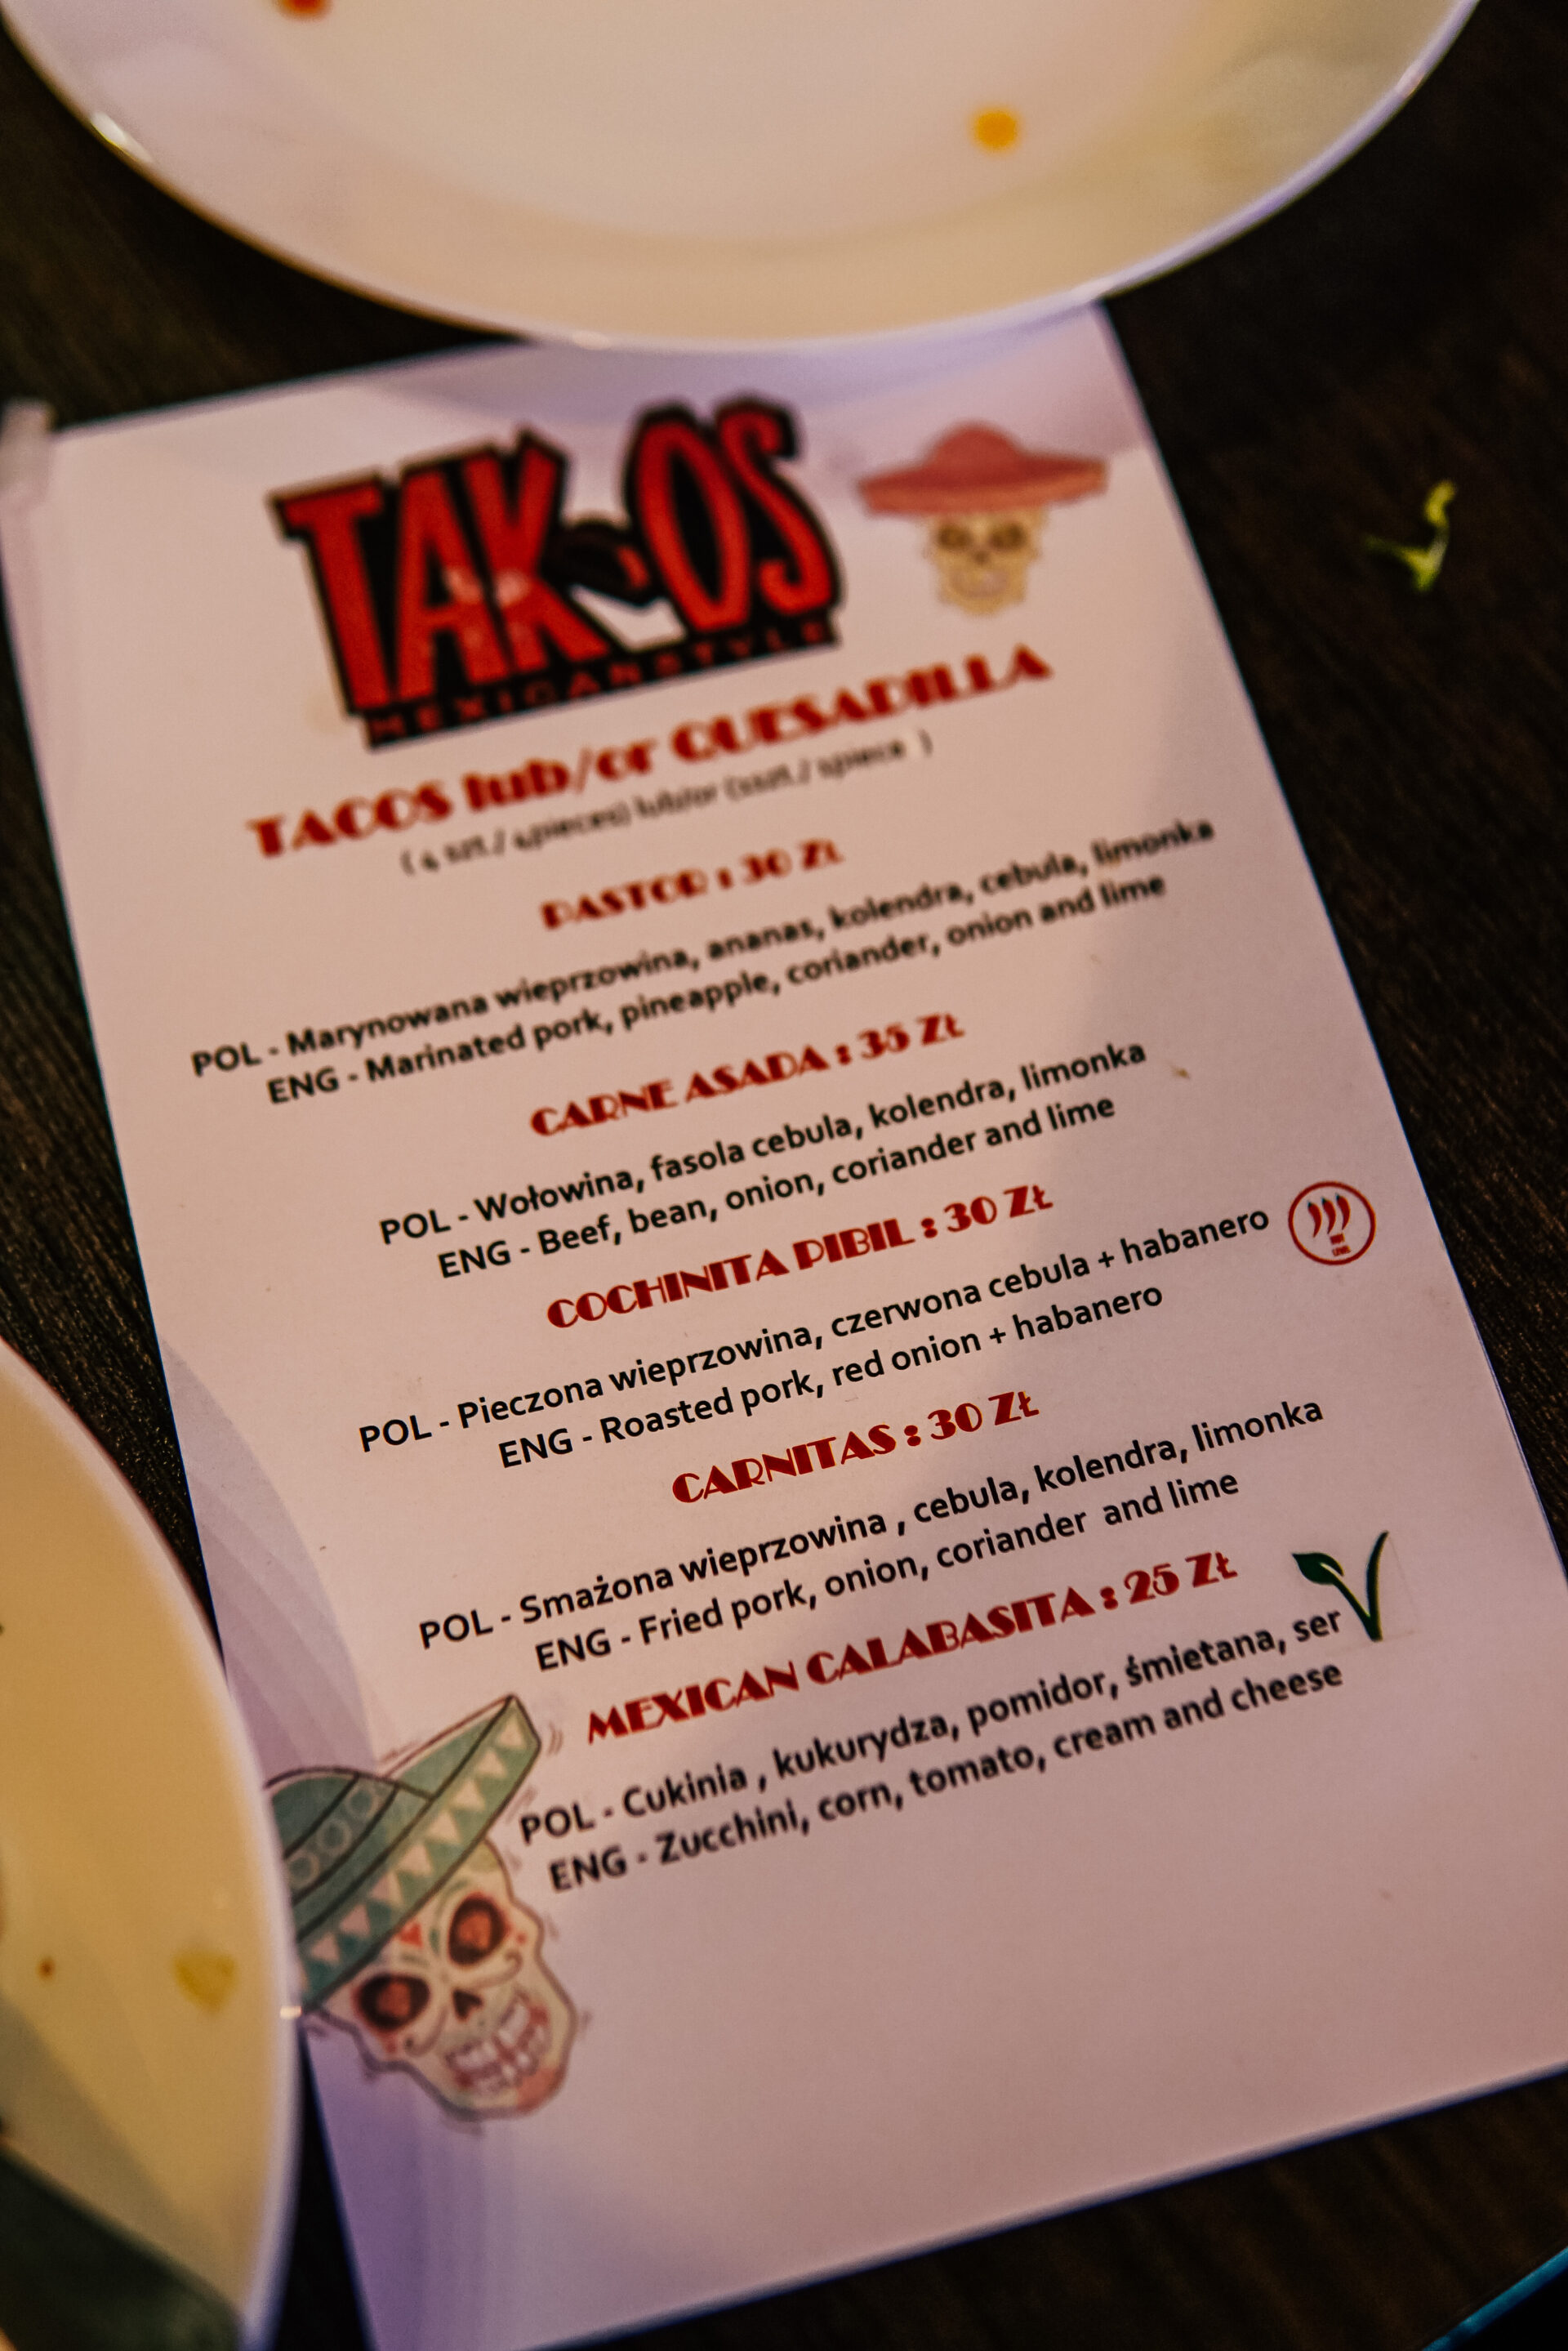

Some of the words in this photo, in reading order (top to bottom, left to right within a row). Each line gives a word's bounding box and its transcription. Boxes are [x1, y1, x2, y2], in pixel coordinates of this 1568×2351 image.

[247, 783, 454, 859] TACOS
[670, 644, 1054, 765] QUESADILLA
[190, 1042, 263, 1077] POL
[285, 994, 490, 1057] Marynowana
[493, 948, 701, 1010] wieprzowina,
[706, 918, 826, 961] ananas,
[827, 882, 974, 931] kolendra,
[978, 852, 1089, 895] cebula,
[1090, 820, 1215, 866] limonka
[539, 868, 708, 931] PASTOR
[741, 849, 792, 885] 30
[798, 838, 844, 872] ZŁ
[266, 1065, 340, 1104] ENG
[365, 1023, 527, 1083] Marinated
[532, 1004, 614, 1052] pork,
[619, 970, 782, 1032] pineapple,
[785, 934, 941, 985] coriander,
[945, 908, 1034, 947] onion
[1038, 887, 1096, 925] and
[1098, 876, 1166, 908] lime
[529, 1078, 679, 1137] CARNE
[684, 1044, 831, 1104] ASADA
[858, 1023, 911, 1060] 35
[379, 1209, 452, 1245] POL
[473, 1170, 645, 1222] Wołowina,
[649, 1140, 746, 1182] fasola
[751, 1113, 863, 1158] cebula,
[867, 1079, 1016, 1129] kolendra,
[1020, 1043, 1147, 1091] limonka
[437, 1239, 511, 1278] ENG
[537, 1213, 621, 1256] Beef,
[626, 1199, 718, 1234] bean,
[724, 1173, 825, 1211] onion,
[831, 1131, 976, 1184] coriander
[985, 1109, 1042, 1147] and
[1046, 1098, 1115, 1131] lime
[359, 1415, 432, 1452] POL
[457, 1378, 604, 1429] Pieczona
[608, 1327, 822, 1391] wieprzowina,
[831, 1285, 982, 1337] czerwona
[988, 1253, 1090, 1297] cebula
[1120, 1211, 1269, 1265] habanero
[546, 1249, 790, 1328] COCHINITA
[792, 1218, 915, 1270] PIBIL
[943, 1196, 997, 1233] 30
[498, 1428, 573, 1468] ENG
[599, 1386, 734, 1443] Roasted
[740, 1369, 823, 1417] pork,
[832, 1349, 884, 1386] red
[891, 1333, 981, 1371] onion
[1012, 1287, 1162, 1340] habanero
[672, 1424, 897, 1503] CARNITAS
[927, 1403, 982, 1440] 30
[419, 1609, 494, 1650] POL
[519, 1568, 674, 1624] Smażona
[679, 1514, 887, 1582] wieprzowina
[914, 1476, 1029, 1523] cebula,
[1033, 1439, 1187, 1492] kolendra,
[1192, 1401, 1323, 1452] limonka
[535, 1627, 612, 1672] ENG
[639, 1597, 724, 1645] Fried
[731, 1579, 817, 1630] pork,
[825, 1556, 929, 1597] onion,
[937, 1512, 1086, 1568] coriander
[1102, 1485, 1164, 1525] and
[1166, 1474, 1239, 1509] lime
[519, 1802, 595, 1845] POL
[622, 1763, 748, 1818] Cukinia
[772, 1715, 960, 1779] kukurydza,
[966, 1672, 1119, 1737] pomidor,
[1125, 1630, 1286, 1688] śmietana,
[1292, 1610, 1341, 1643] ser
[588, 1661, 800, 1745] MEXICAN
[806, 1586, 1096, 1685] CALABASITA
[1124, 1563, 1179, 1604] 25
[549, 1845, 627, 1892] ENG
[655, 1798, 810, 1865] Zucchini,
[817, 1782, 903, 1822] corn,
[908, 1745, 1046, 1797] tomato,
[1053, 1713, 1156, 1759] cream
[1162, 1688, 1225, 1730] and
[1230, 1664, 1343, 1711] cheese
